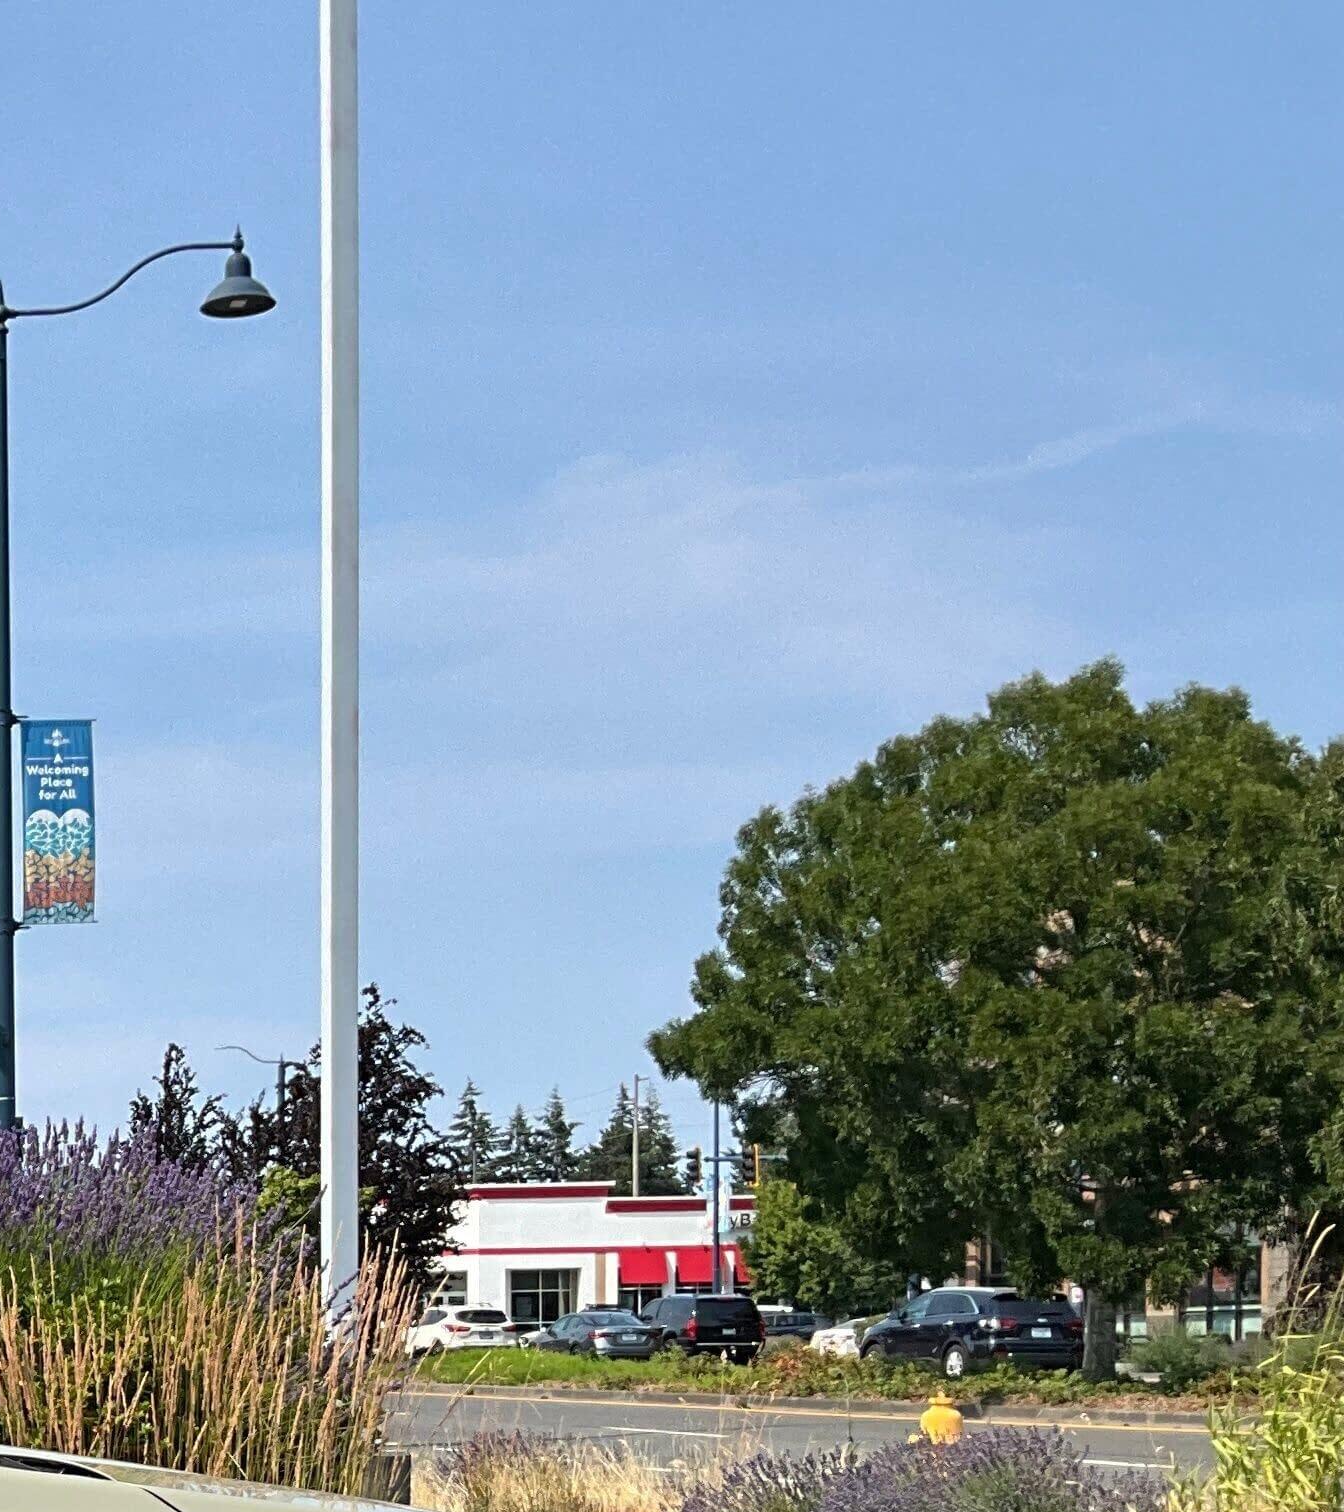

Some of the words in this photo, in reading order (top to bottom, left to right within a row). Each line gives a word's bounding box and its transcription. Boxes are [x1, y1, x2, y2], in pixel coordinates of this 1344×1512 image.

[53, 753, 64, 764] A
[26, 764, 89, 777] Welcoming
[40, 776, 73, 788] Place
[38, 789, 58, 801] for
[59, 788, 77, 800] All
